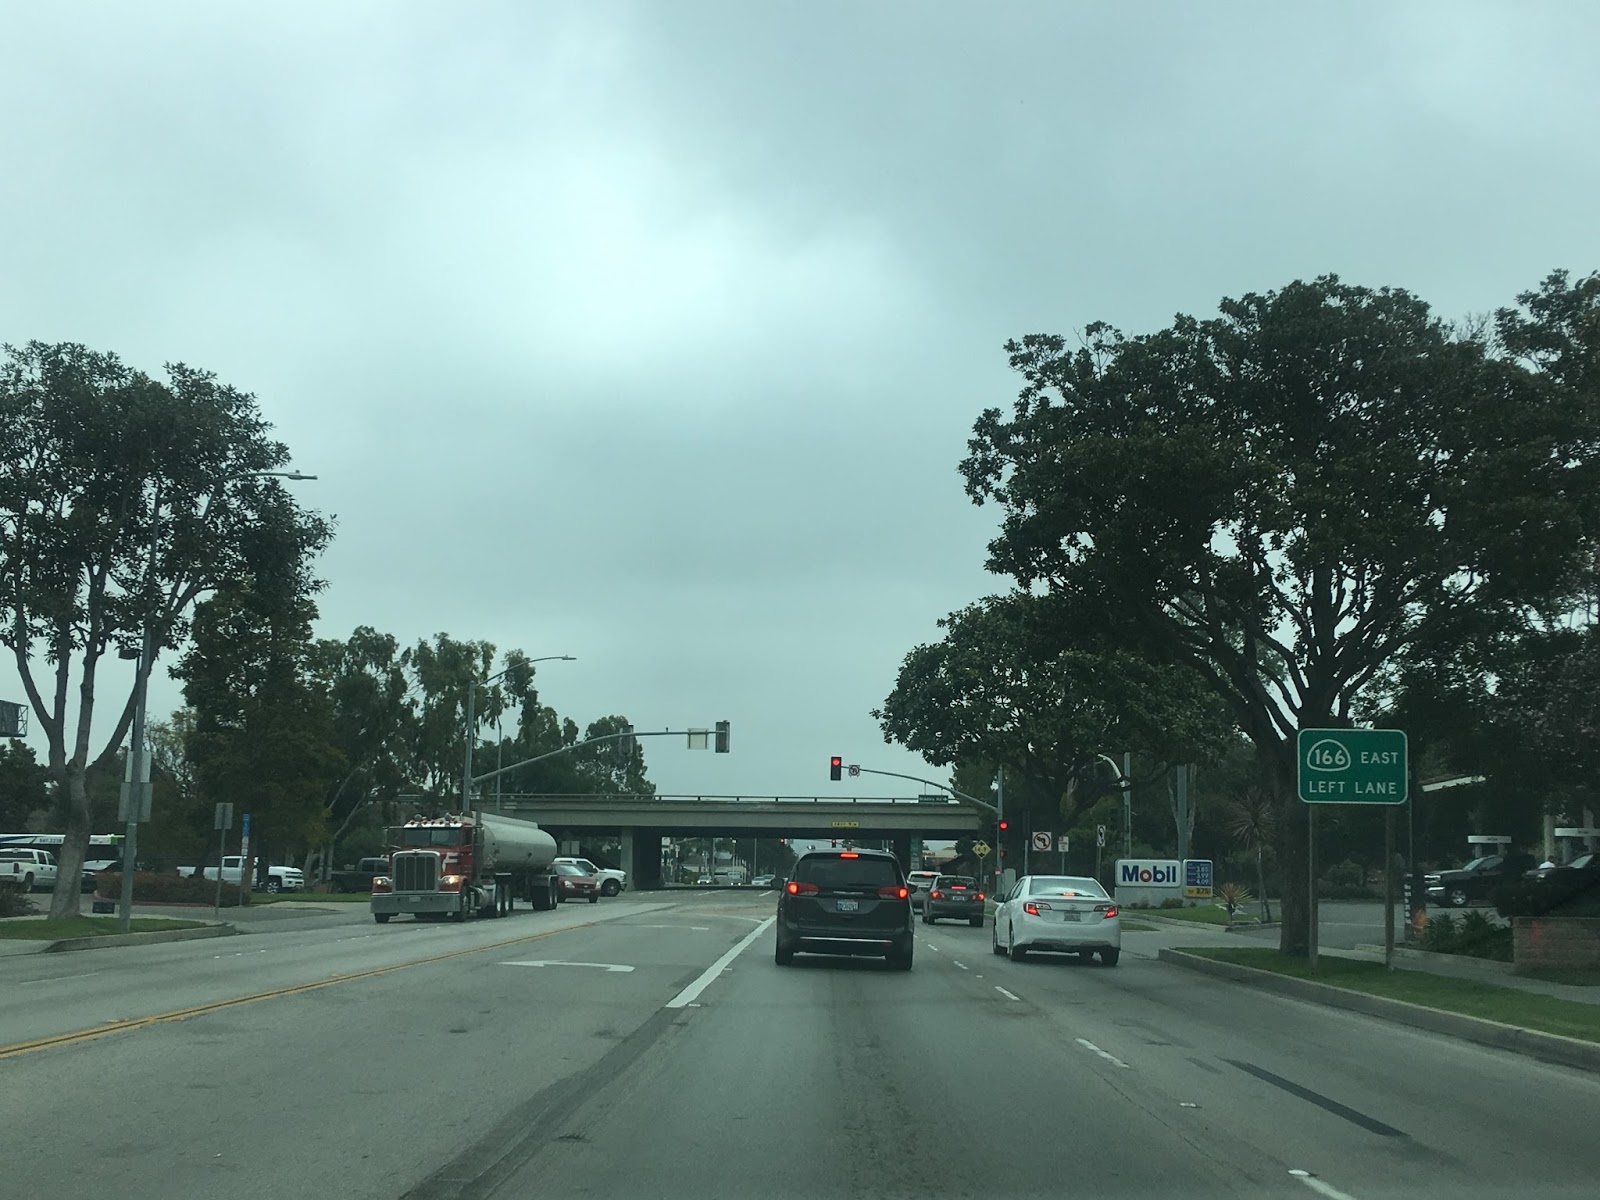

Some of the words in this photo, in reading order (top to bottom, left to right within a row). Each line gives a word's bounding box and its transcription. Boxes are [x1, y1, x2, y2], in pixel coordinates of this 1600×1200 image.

[1315, 748, 1346, 765] 166
[1361, 751, 1398, 764] EAST
[1309, 781, 1345, 793] LEFT
[1355, 782, 1397, 794] LANE
[1122, 865, 1176, 883] Mobil
